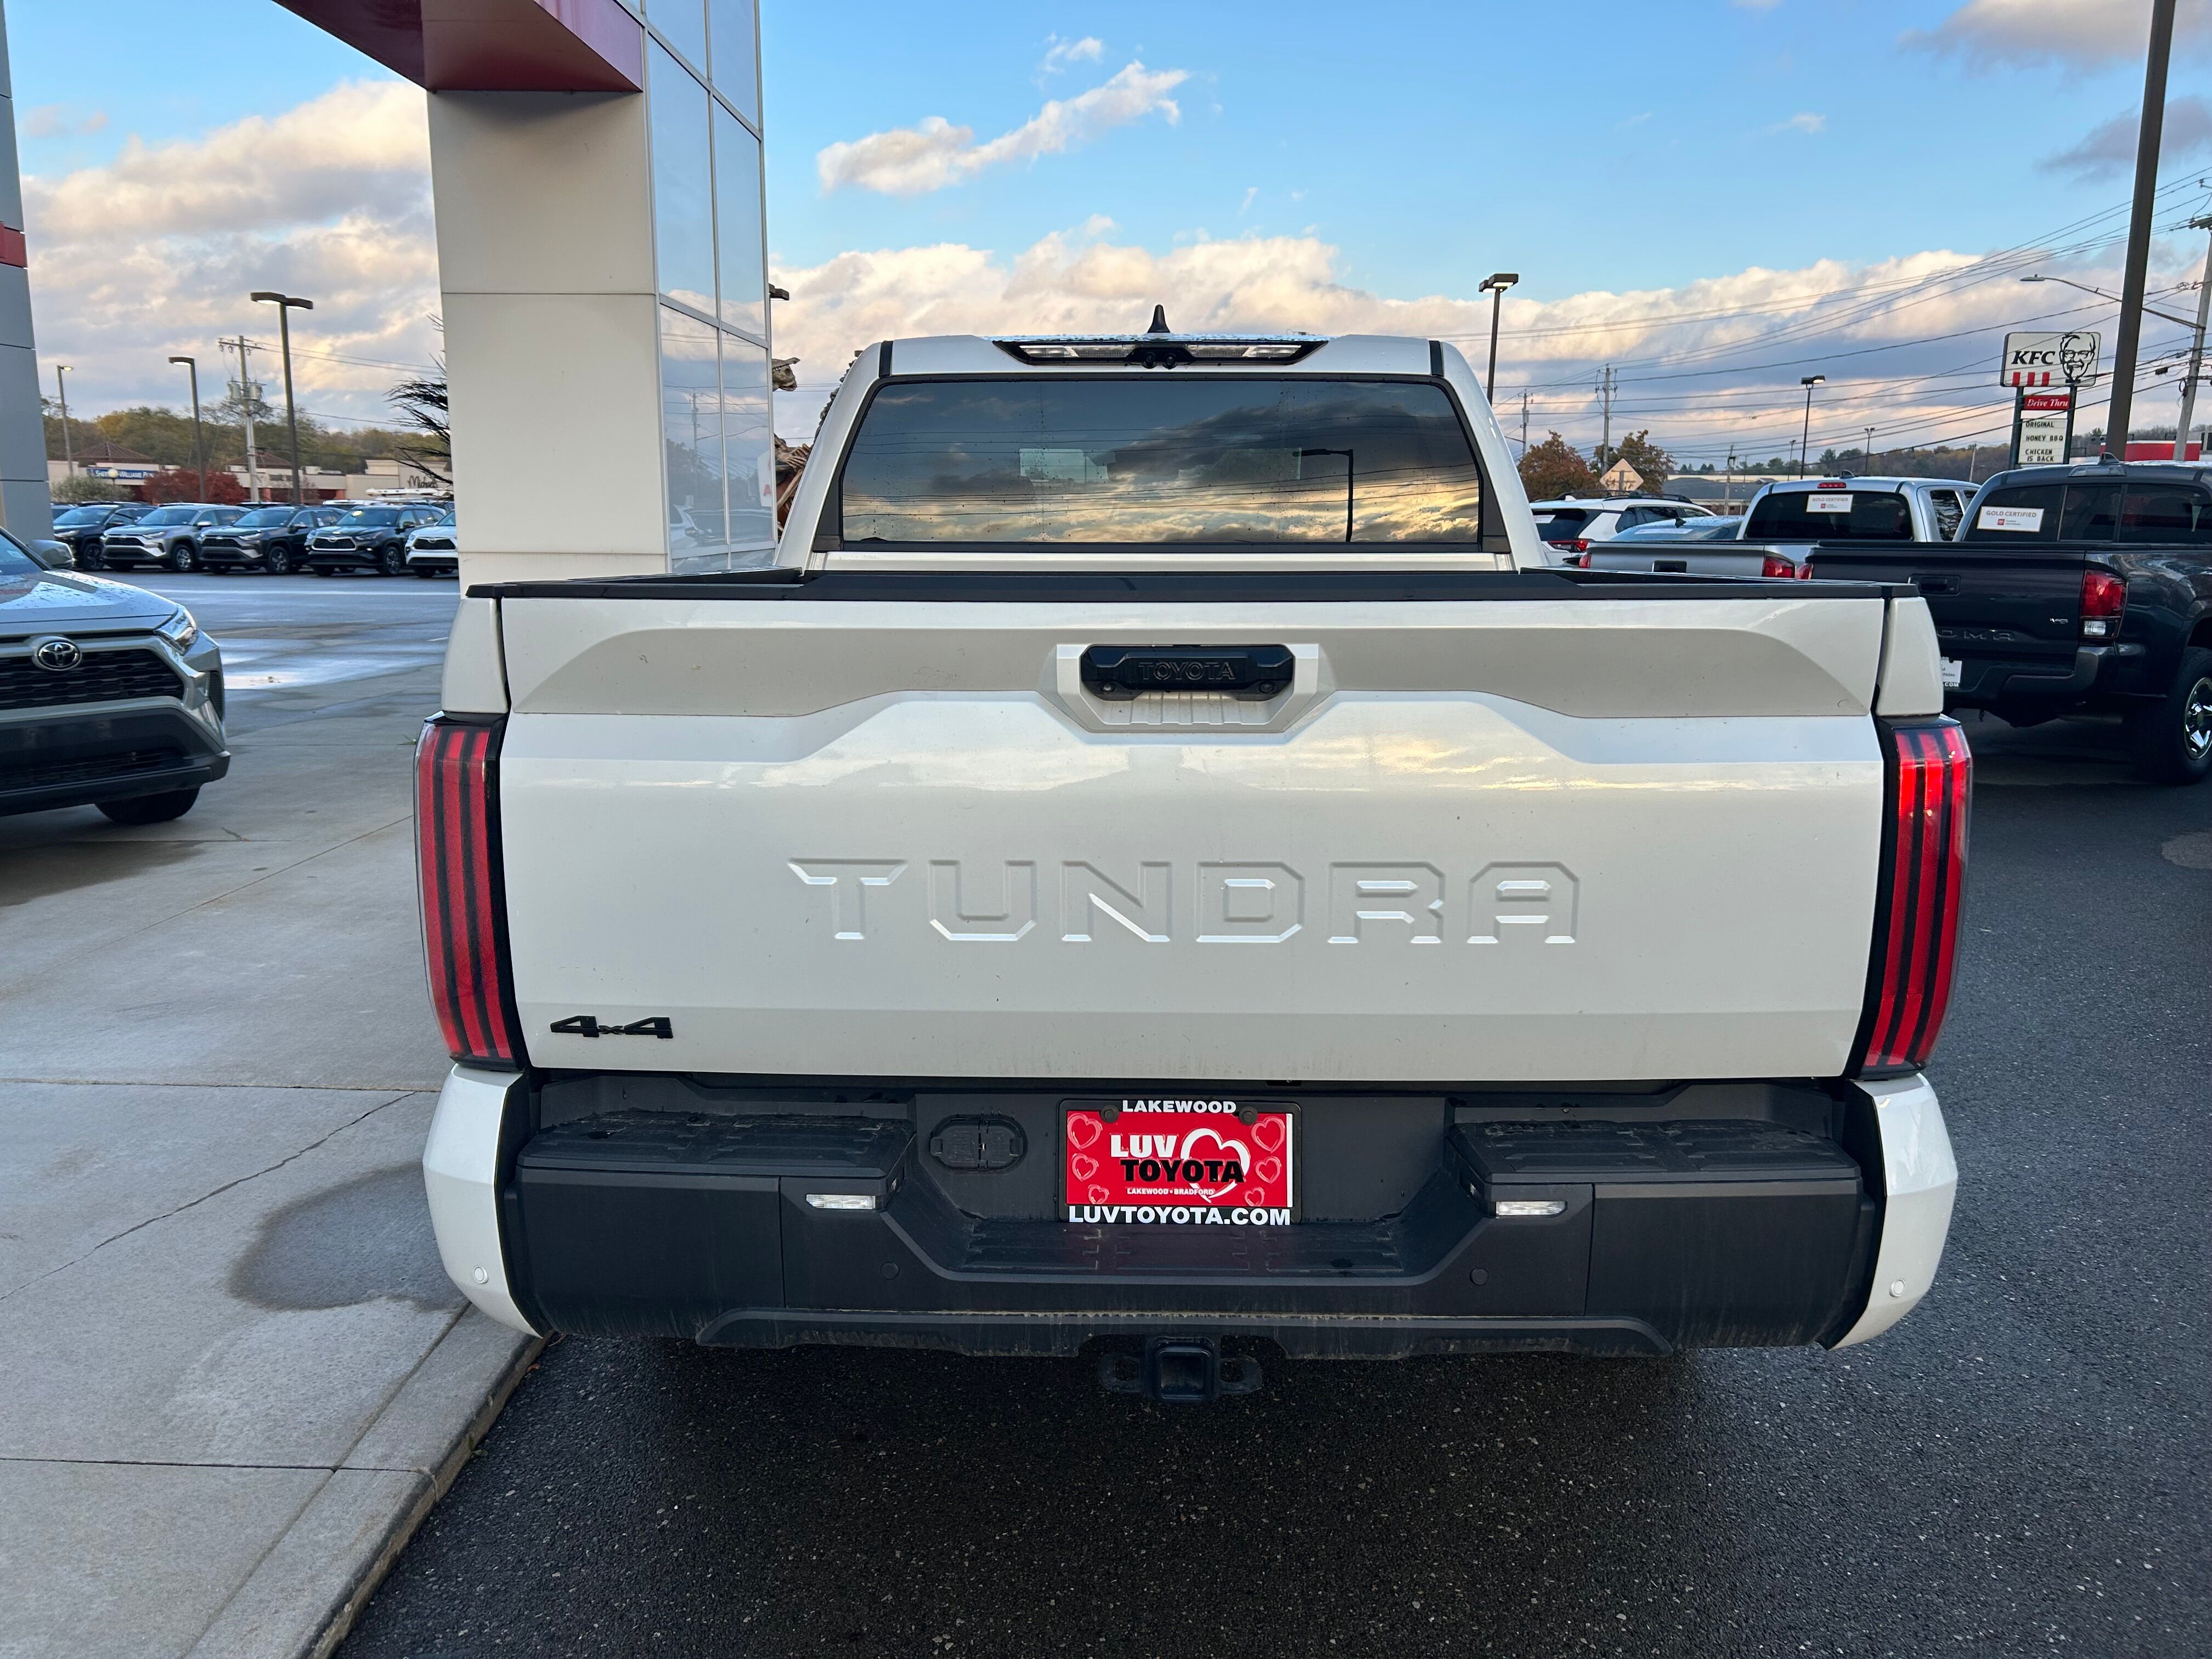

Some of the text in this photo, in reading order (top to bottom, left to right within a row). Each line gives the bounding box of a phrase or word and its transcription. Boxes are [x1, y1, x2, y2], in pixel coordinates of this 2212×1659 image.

[2011, 351, 2056, 365] KFC
[2027, 398, 2068, 407] Drive Thru
[1139, 662, 1236, 680] TOYOTA
[788, 857, 1580, 945] TUNDRA
[550, 1015, 673, 1039] 4x4
[1122, 1100, 1237, 1114] LAKEWOOD
[1110, 1133, 1178, 1159] LUV
[1120, 1159, 1245, 1183] TOYOTA
[1068, 1205, 1291, 1226] LUVTOYOTA.COM
